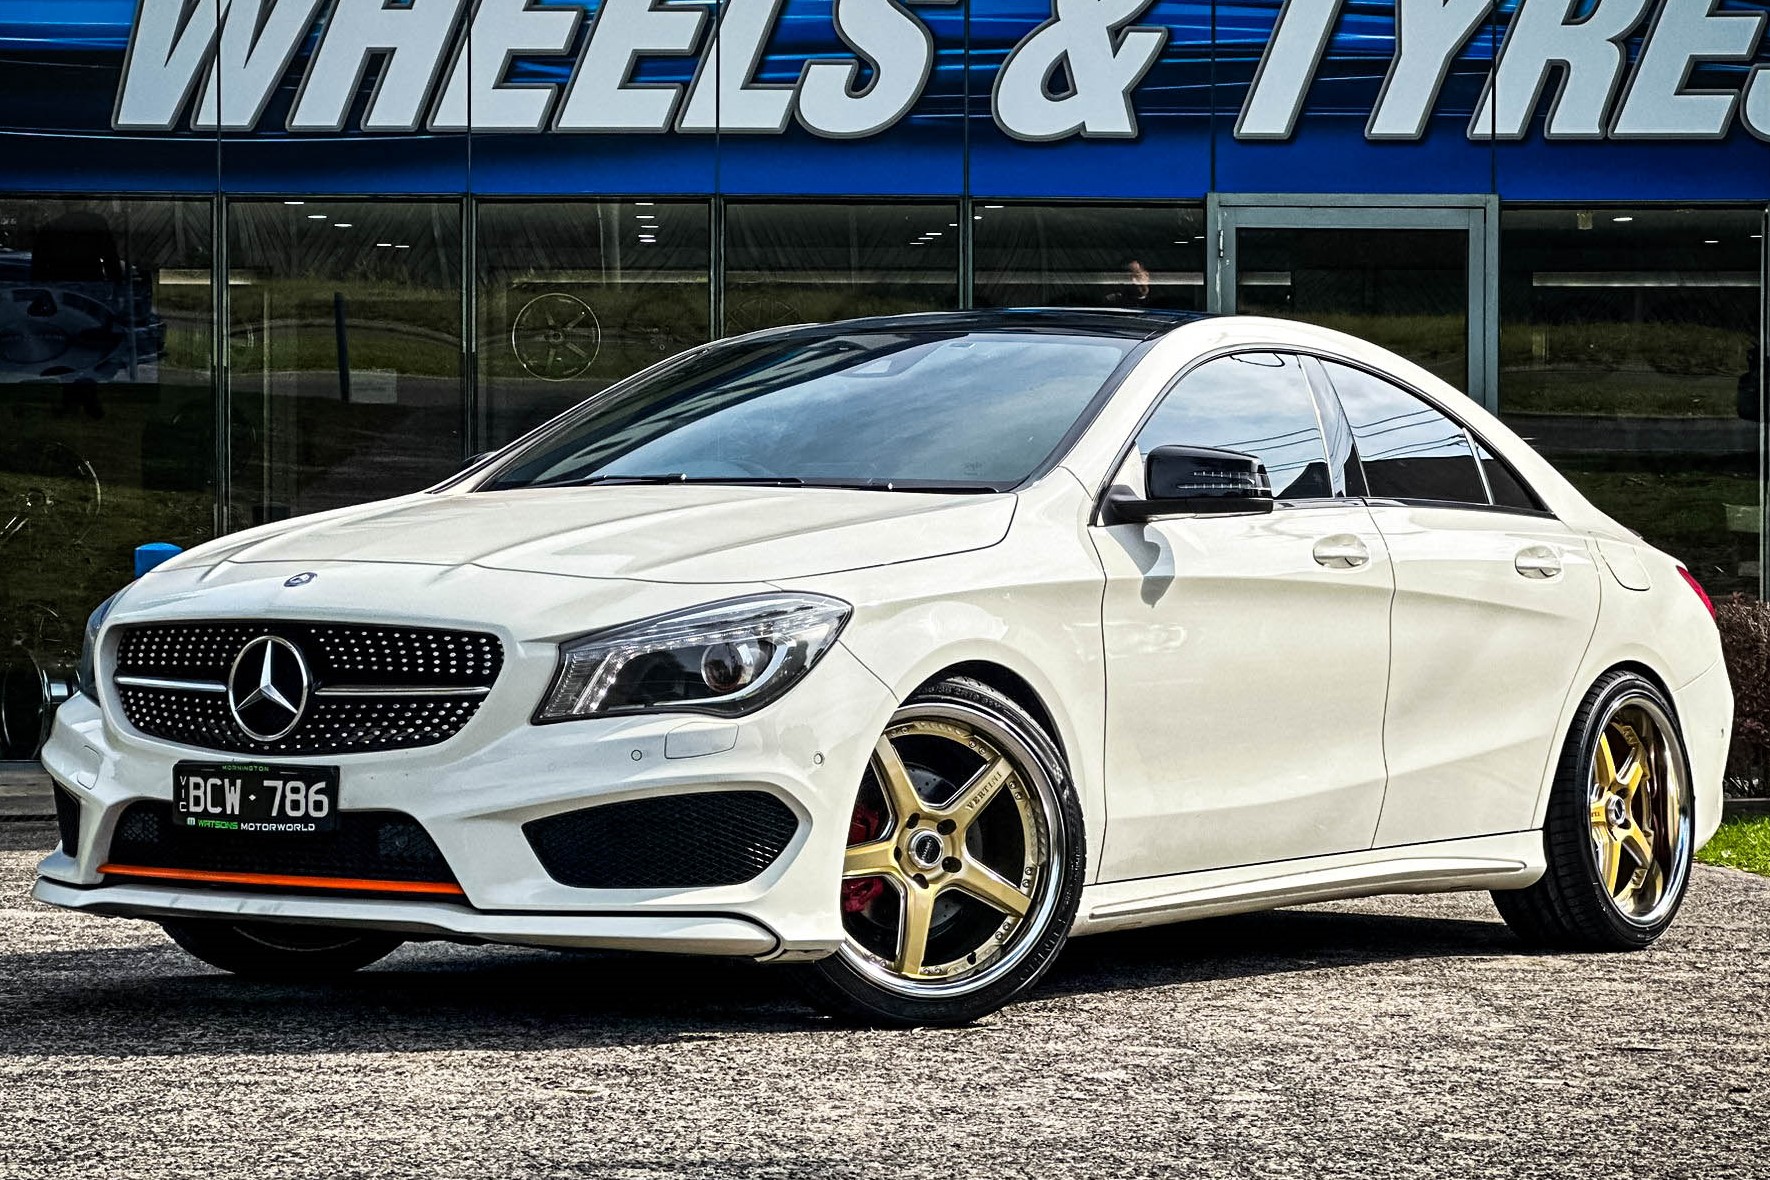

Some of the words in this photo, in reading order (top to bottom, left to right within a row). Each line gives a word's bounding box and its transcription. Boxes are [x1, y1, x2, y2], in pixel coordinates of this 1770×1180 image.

[112, 0, 935, 139] WHEELS
[991, 0, 1168, 142] &
[179, 775, 187, 812] VIC
[189, 776, 242, 815] BCW
[263, 780, 329, 818] 786
[965, 771, 1002, 811] VERTINI
[198, 819, 238, 830] WATSONS
[240, 822, 315, 832] MOTORWORLD
